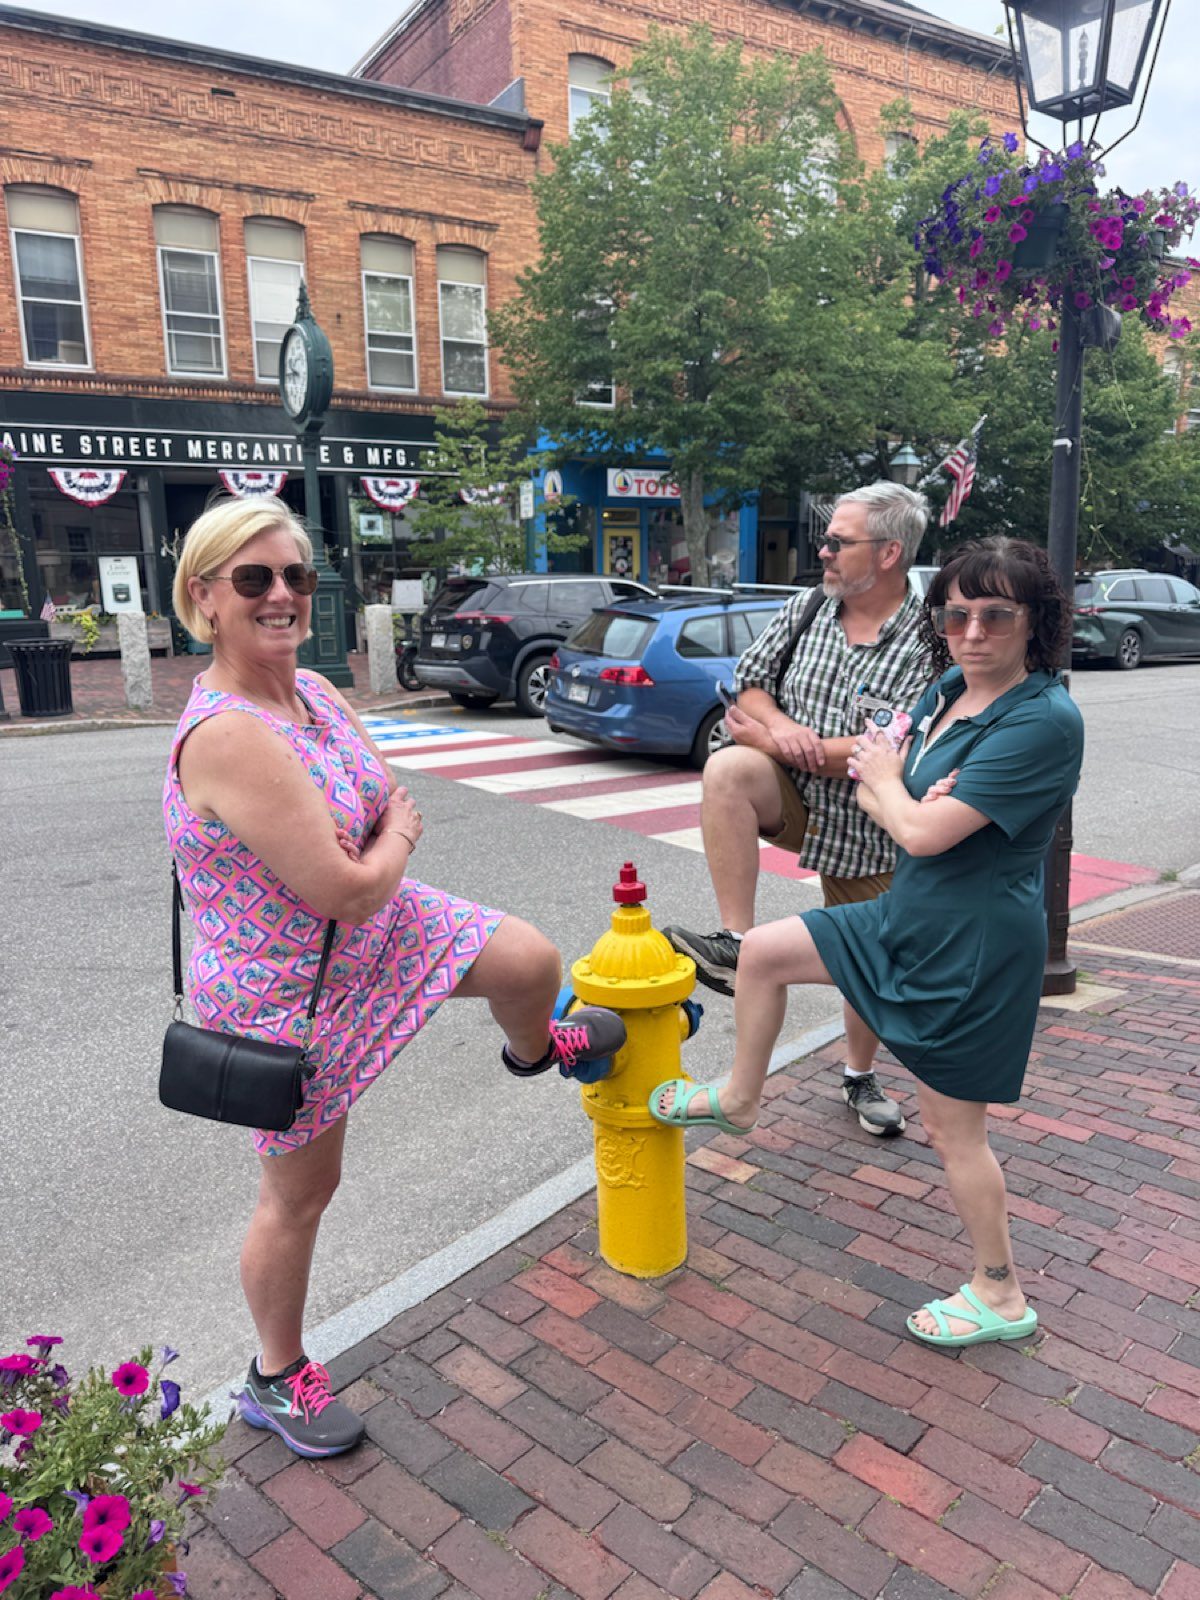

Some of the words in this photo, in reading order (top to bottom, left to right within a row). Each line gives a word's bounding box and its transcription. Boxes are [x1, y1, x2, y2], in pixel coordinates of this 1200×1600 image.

[80, 435, 172, 457] STREET
[187, 439, 331, 464] MERCANTIE
[343, 446, 354, 464] &
[367, 447, 415, 466] MFG.
[634, 479, 681, 496] TOYS
